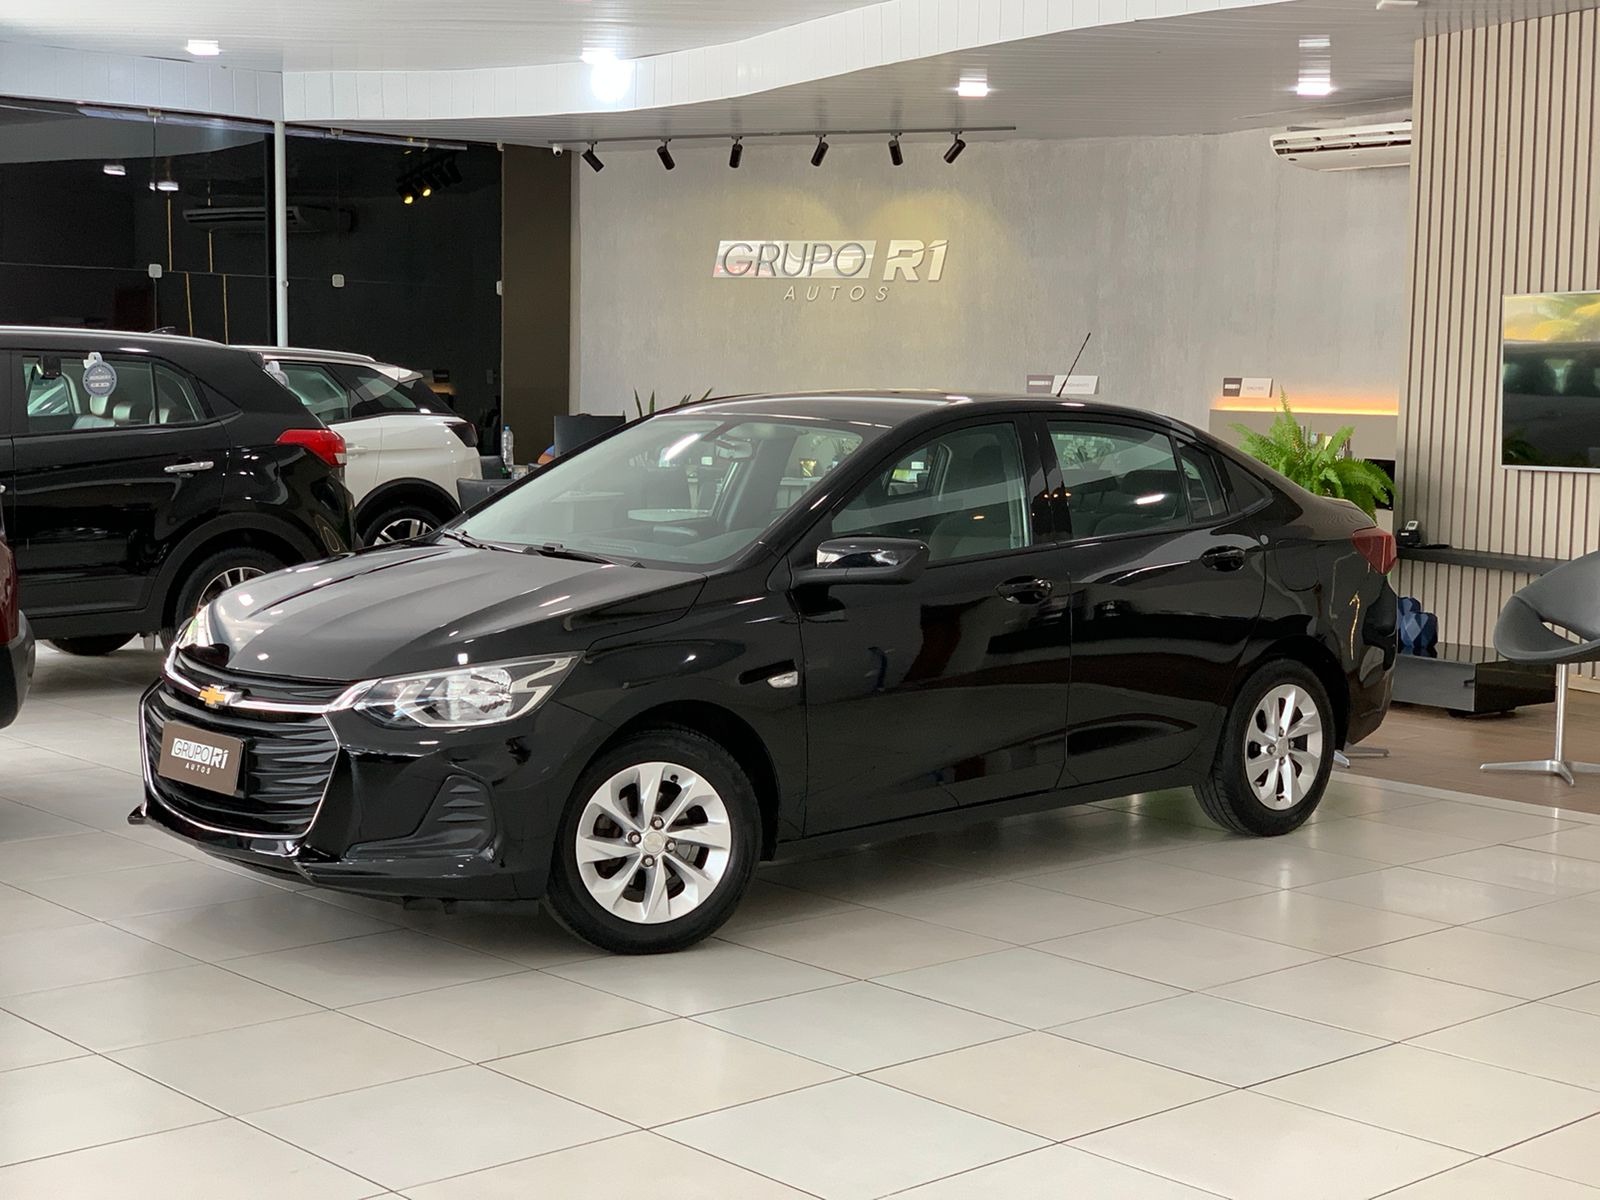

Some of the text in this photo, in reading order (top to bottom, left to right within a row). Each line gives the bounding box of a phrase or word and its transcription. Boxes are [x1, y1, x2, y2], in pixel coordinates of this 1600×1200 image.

[721, 240, 949, 281] GRUPO R1
[784, 286, 889, 301] AUTOS
[172, 739, 229, 769] GRUPO R1
[185, 762, 211, 775] AUTOS
